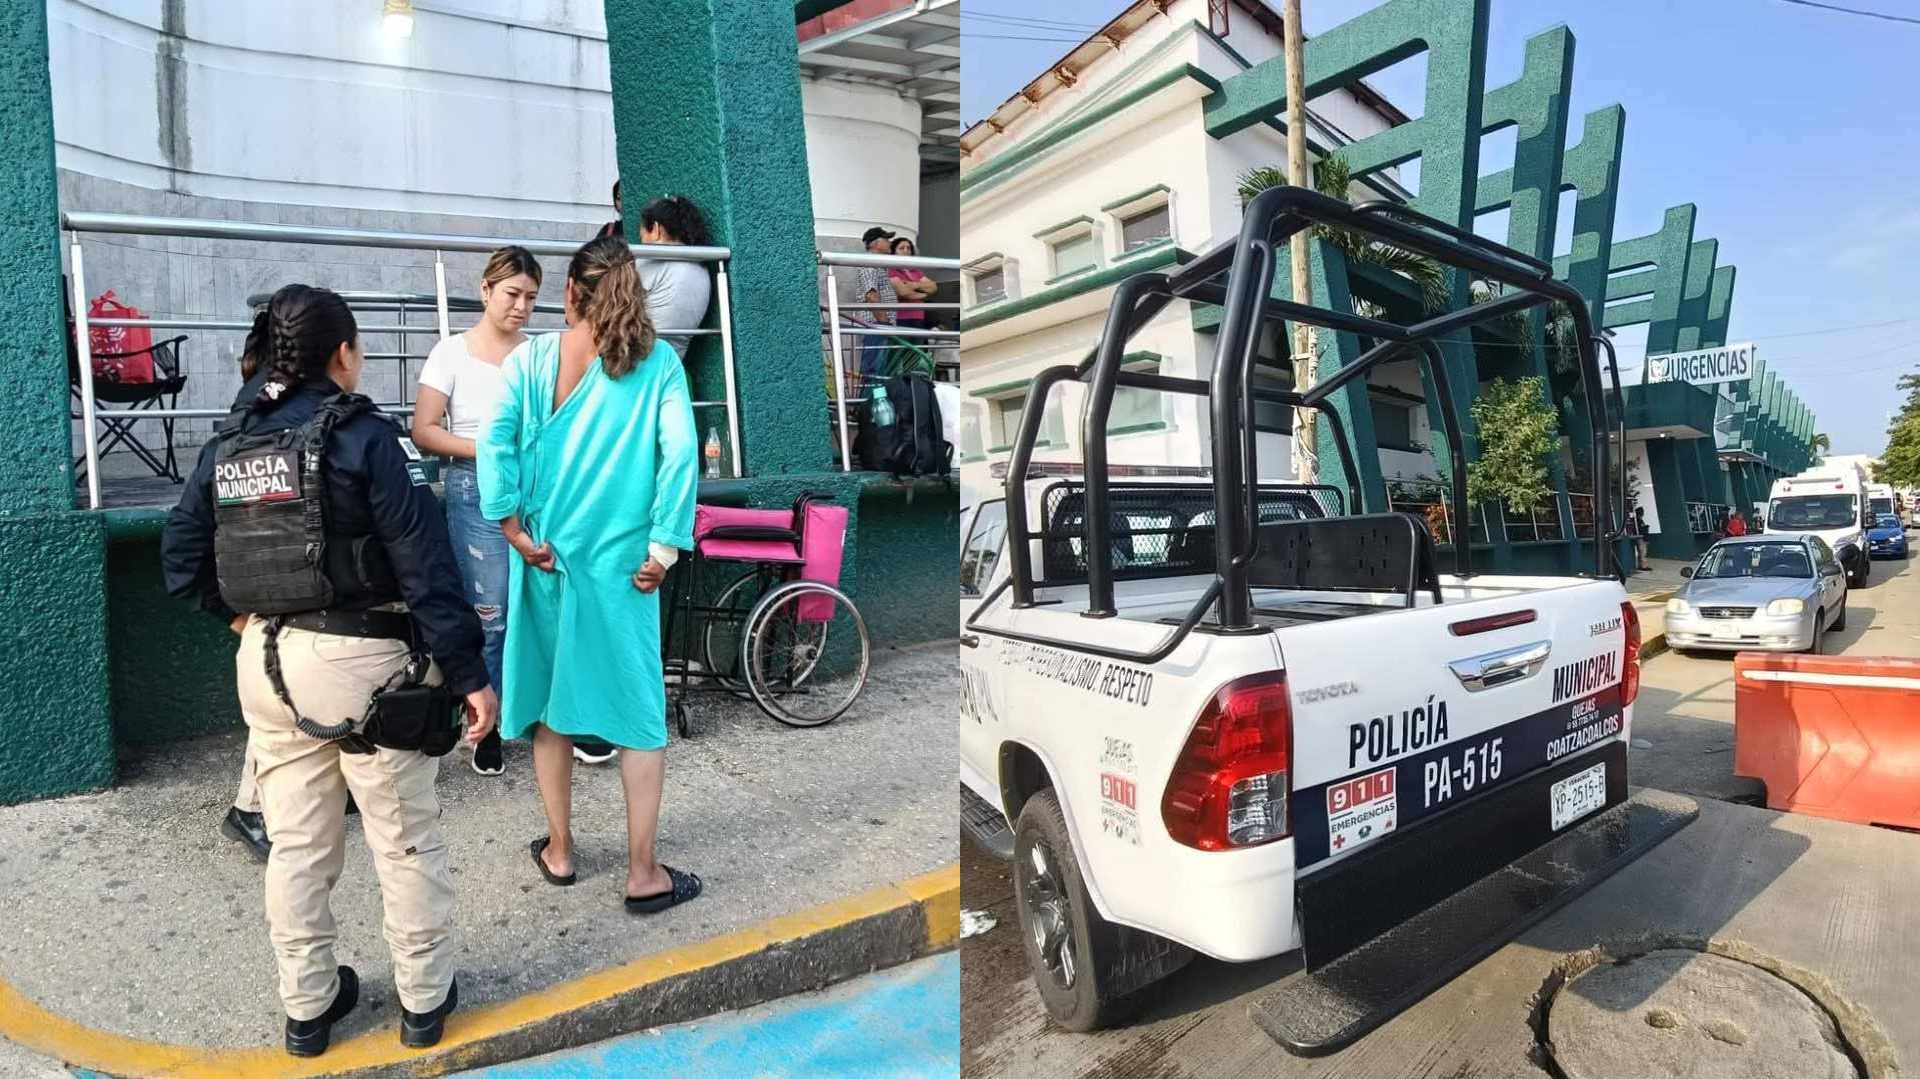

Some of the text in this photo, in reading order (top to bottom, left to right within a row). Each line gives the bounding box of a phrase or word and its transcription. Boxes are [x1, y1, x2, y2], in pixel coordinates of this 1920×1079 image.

[1671, 348, 1748, 381] URGENCIAS
[215, 455, 290, 481] POLICÍA
[216, 474, 293, 499] MUNICIPAL
[1099, 664, 1154, 707] RESPETO
[1348, 651, 1617, 768] POLICÍA MUNICIPAL
[1571, 697, 1597, 720] QUEJAS
[1546, 713, 1619, 761] COATZACOALCOS
[1424, 736, 1504, 809] PA-515
[1334, 774, 1389, 809] 911
[1331, 802, 1396, 834] EMERGENCIAS
